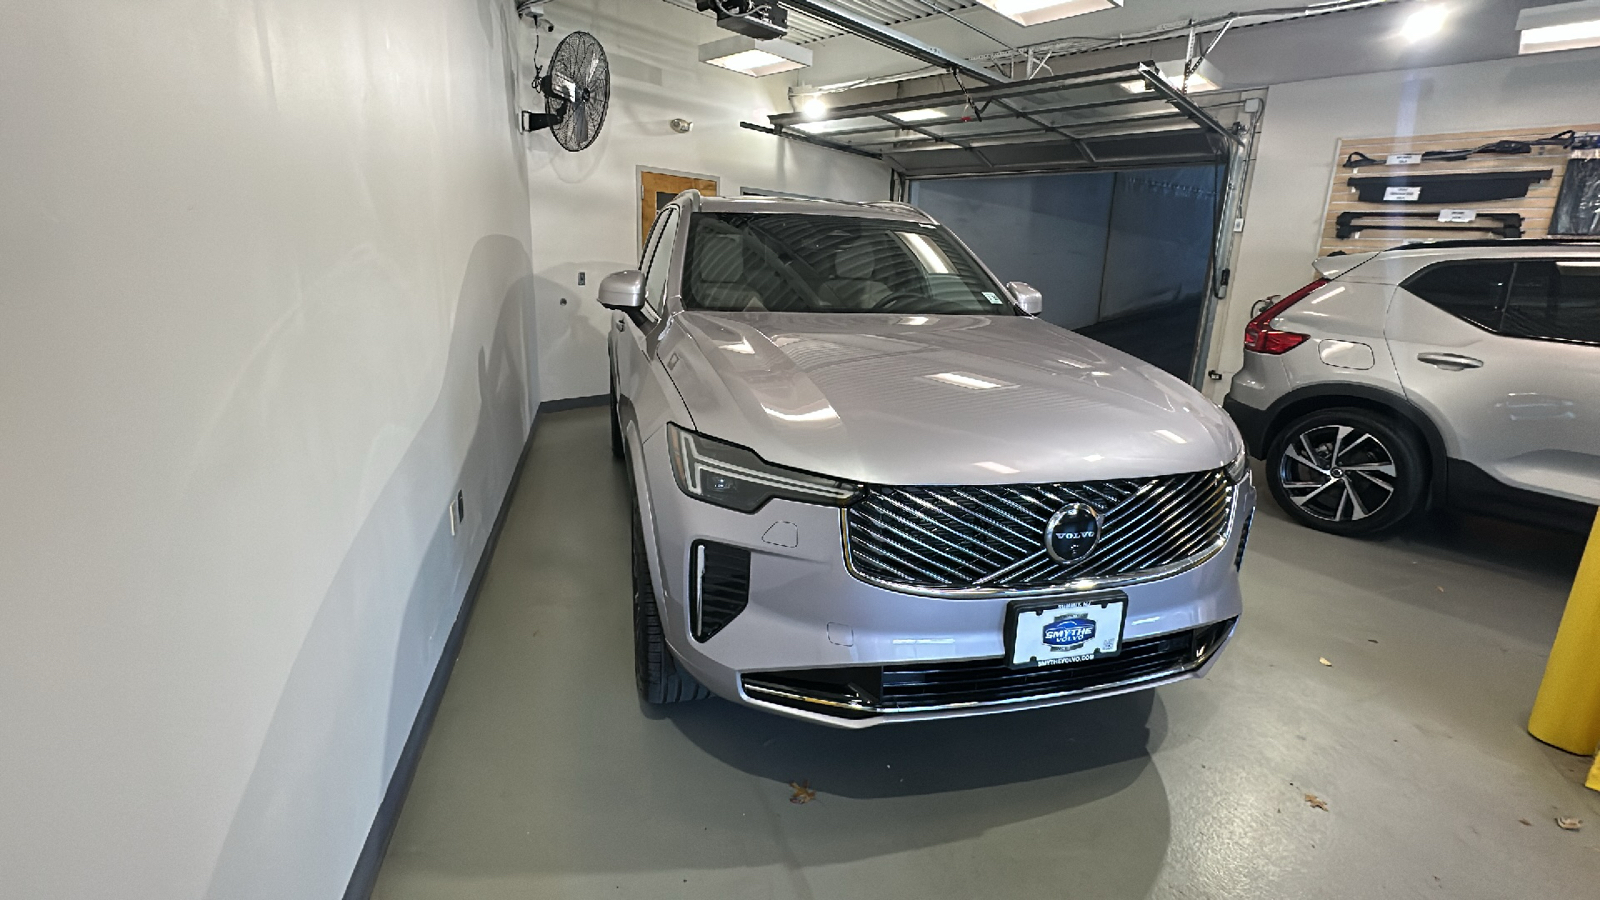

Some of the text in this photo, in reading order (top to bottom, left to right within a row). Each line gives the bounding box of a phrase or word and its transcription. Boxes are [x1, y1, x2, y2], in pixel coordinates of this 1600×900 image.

[1055, 531, 1095, 540] VOLVO
[1045, 627, 1093, 639] SMYTHE
[1056, 634, 1084, 643] VOLVO
[1037, 654, 1095, 668] SMYTHEVOLVO.COM
